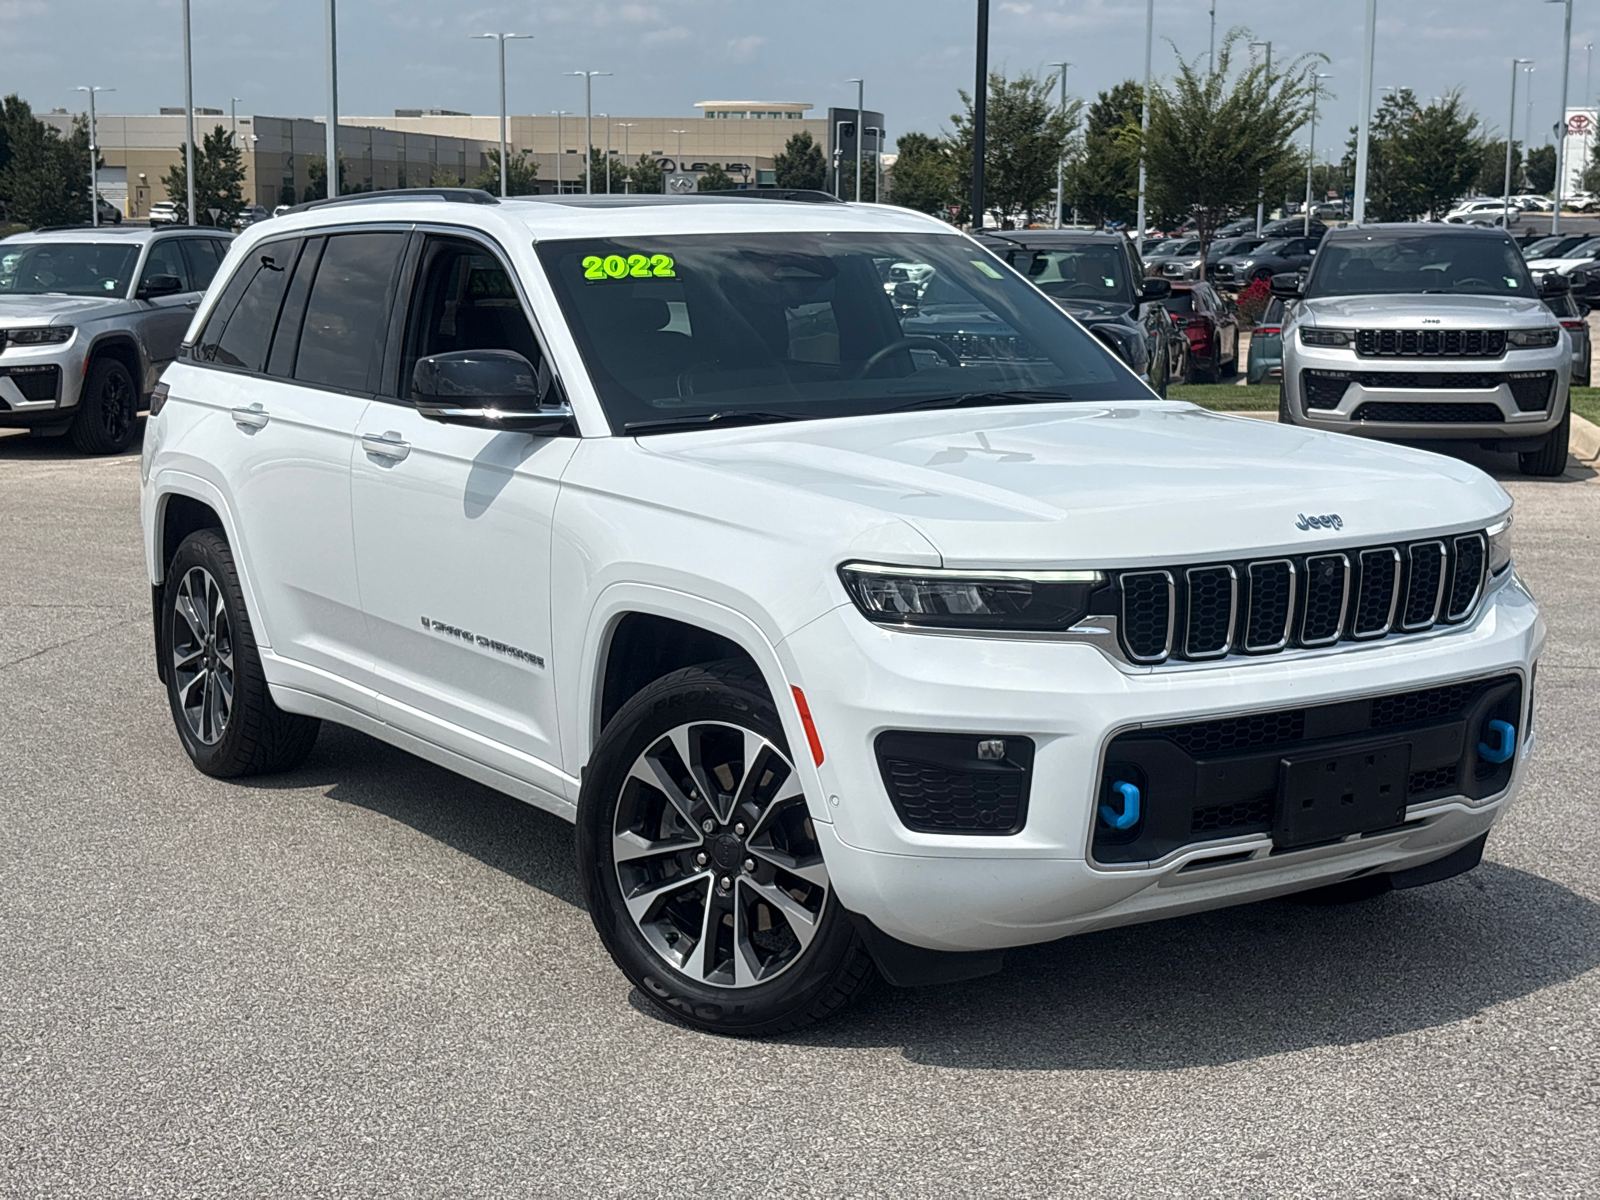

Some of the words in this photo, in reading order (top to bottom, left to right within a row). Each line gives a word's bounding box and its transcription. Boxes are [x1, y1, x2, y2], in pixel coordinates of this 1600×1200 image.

[680, 162, 746, 172] LEUS
[582, 254, 676, 280] 2022
[1421, 317, 1441, 325] Jeep
[1294, 512, 1343, 531] Jeep
[431, 619, 475, 643] GRAND
[475, 635, 546, 669] CHEROKEE
[642, 975, 749, 1022] TOYO
